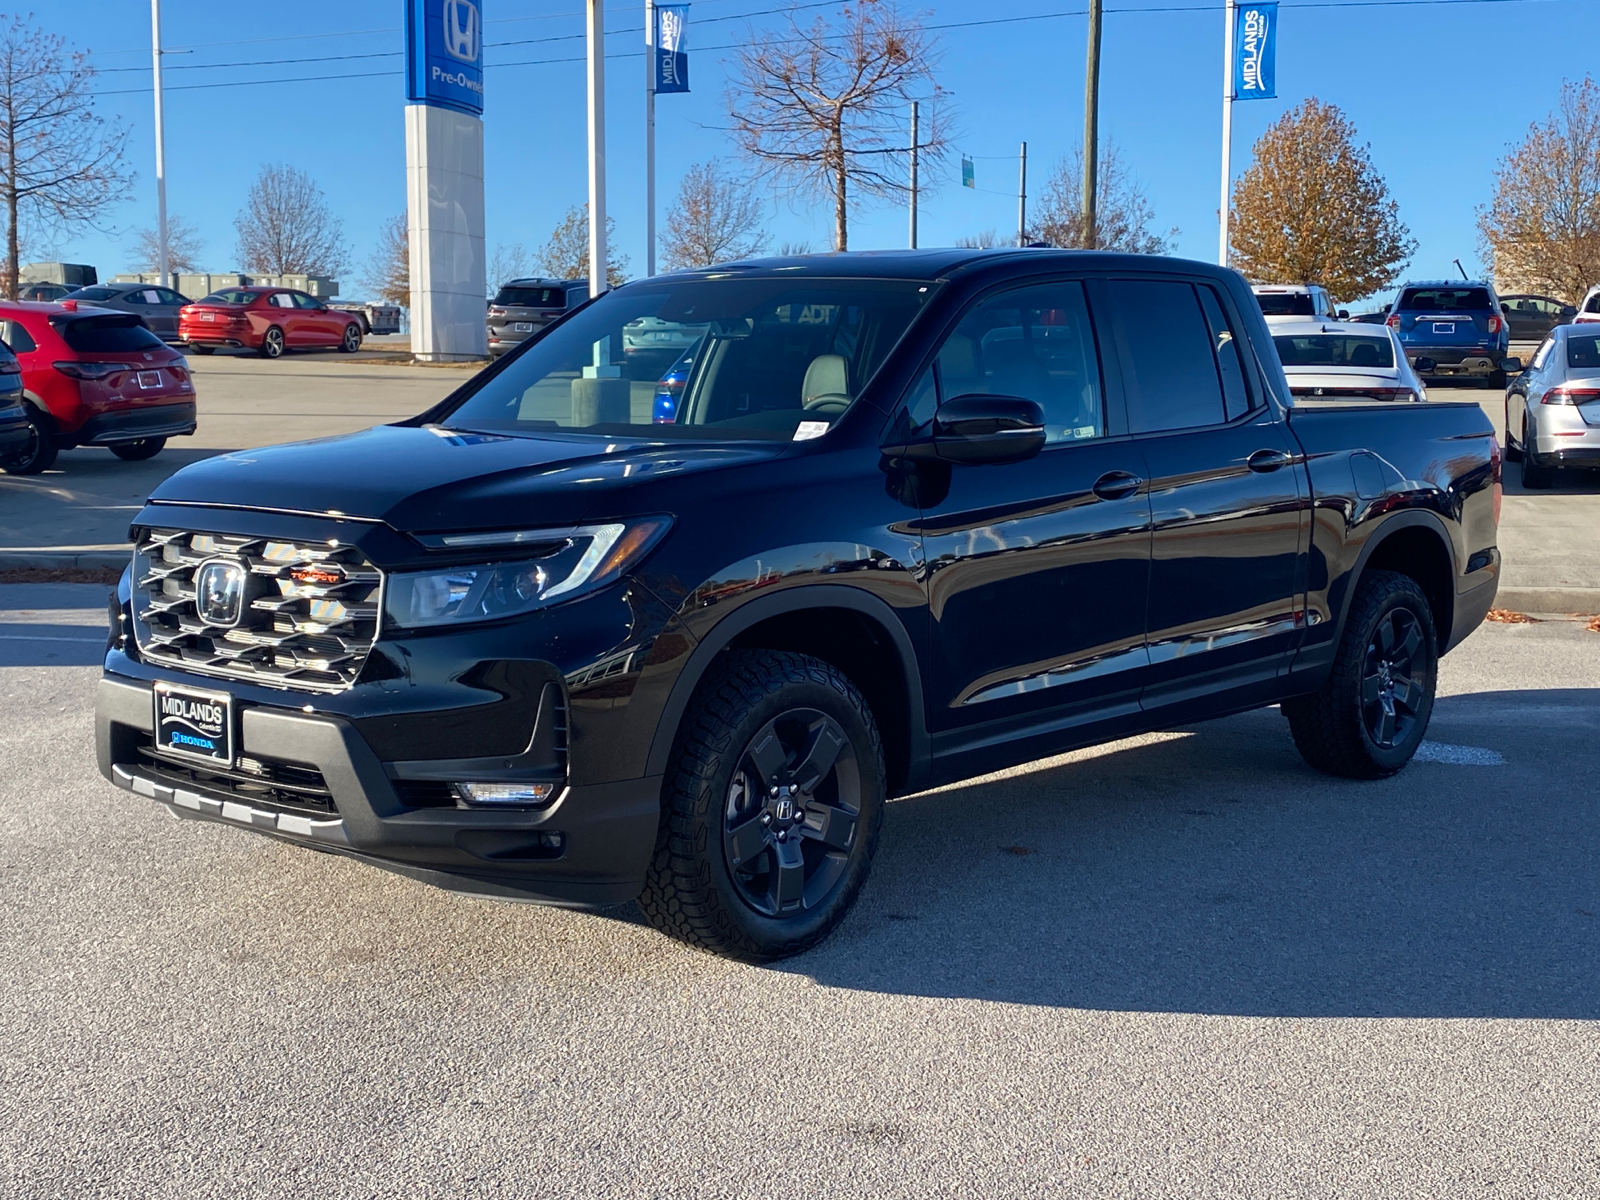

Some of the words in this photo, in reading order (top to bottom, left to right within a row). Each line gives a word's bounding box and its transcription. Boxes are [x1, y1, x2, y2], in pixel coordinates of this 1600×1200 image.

[662, 10, 673, 84] MIDLANDS
[1243, 9, 1259, 90] MIDLANDS
[797, 304, 835, 325] ADT
[161, 696, 222, 725] MIDLANDS
[179, 734, 215, 749] HONDA
